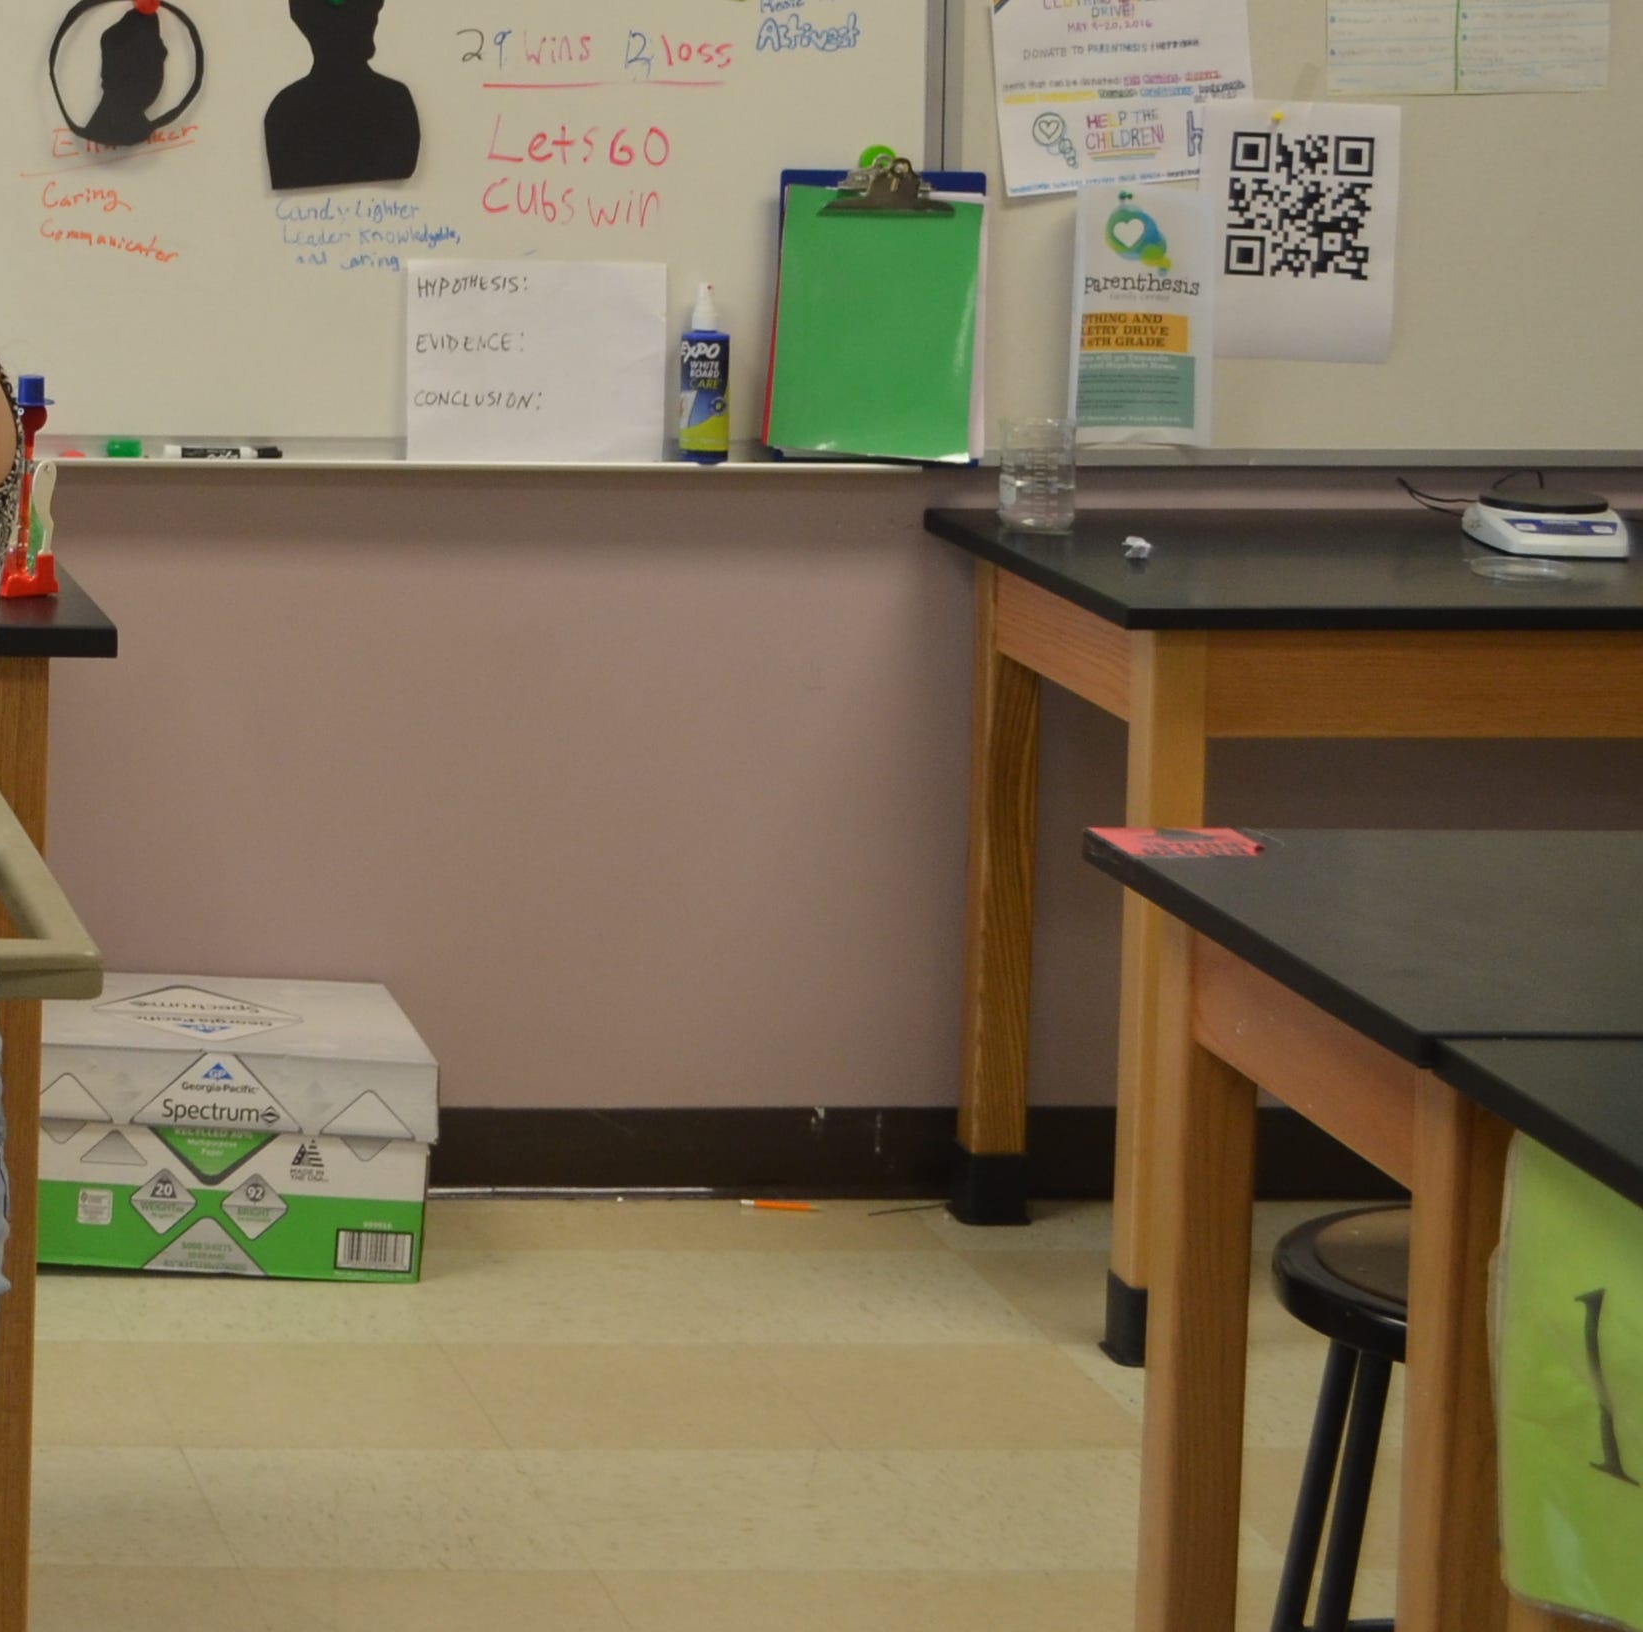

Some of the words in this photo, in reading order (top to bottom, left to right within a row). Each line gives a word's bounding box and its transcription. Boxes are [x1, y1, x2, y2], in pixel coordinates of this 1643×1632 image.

[660, 33, 735, 69] loss
[1086, 110, 1128, 130] HELP
[41, 180, 132, 212] Caring
[416, 274, 529, 300] HYPOTHESIS:
[1083, 272, 1201, 296] parenthesis
[1131, 313, 1163, 324] AND
[1123, 324, 1170, 337] DRIVE
[1115, 336, 1166, 348] GRADE
[689, 368, 721, 378] BOARD
[161, 1097, 260, 1123] Spectrum
[155, 1183, 174, 1198] 20
[246, 1186, 264, 1201] 92
